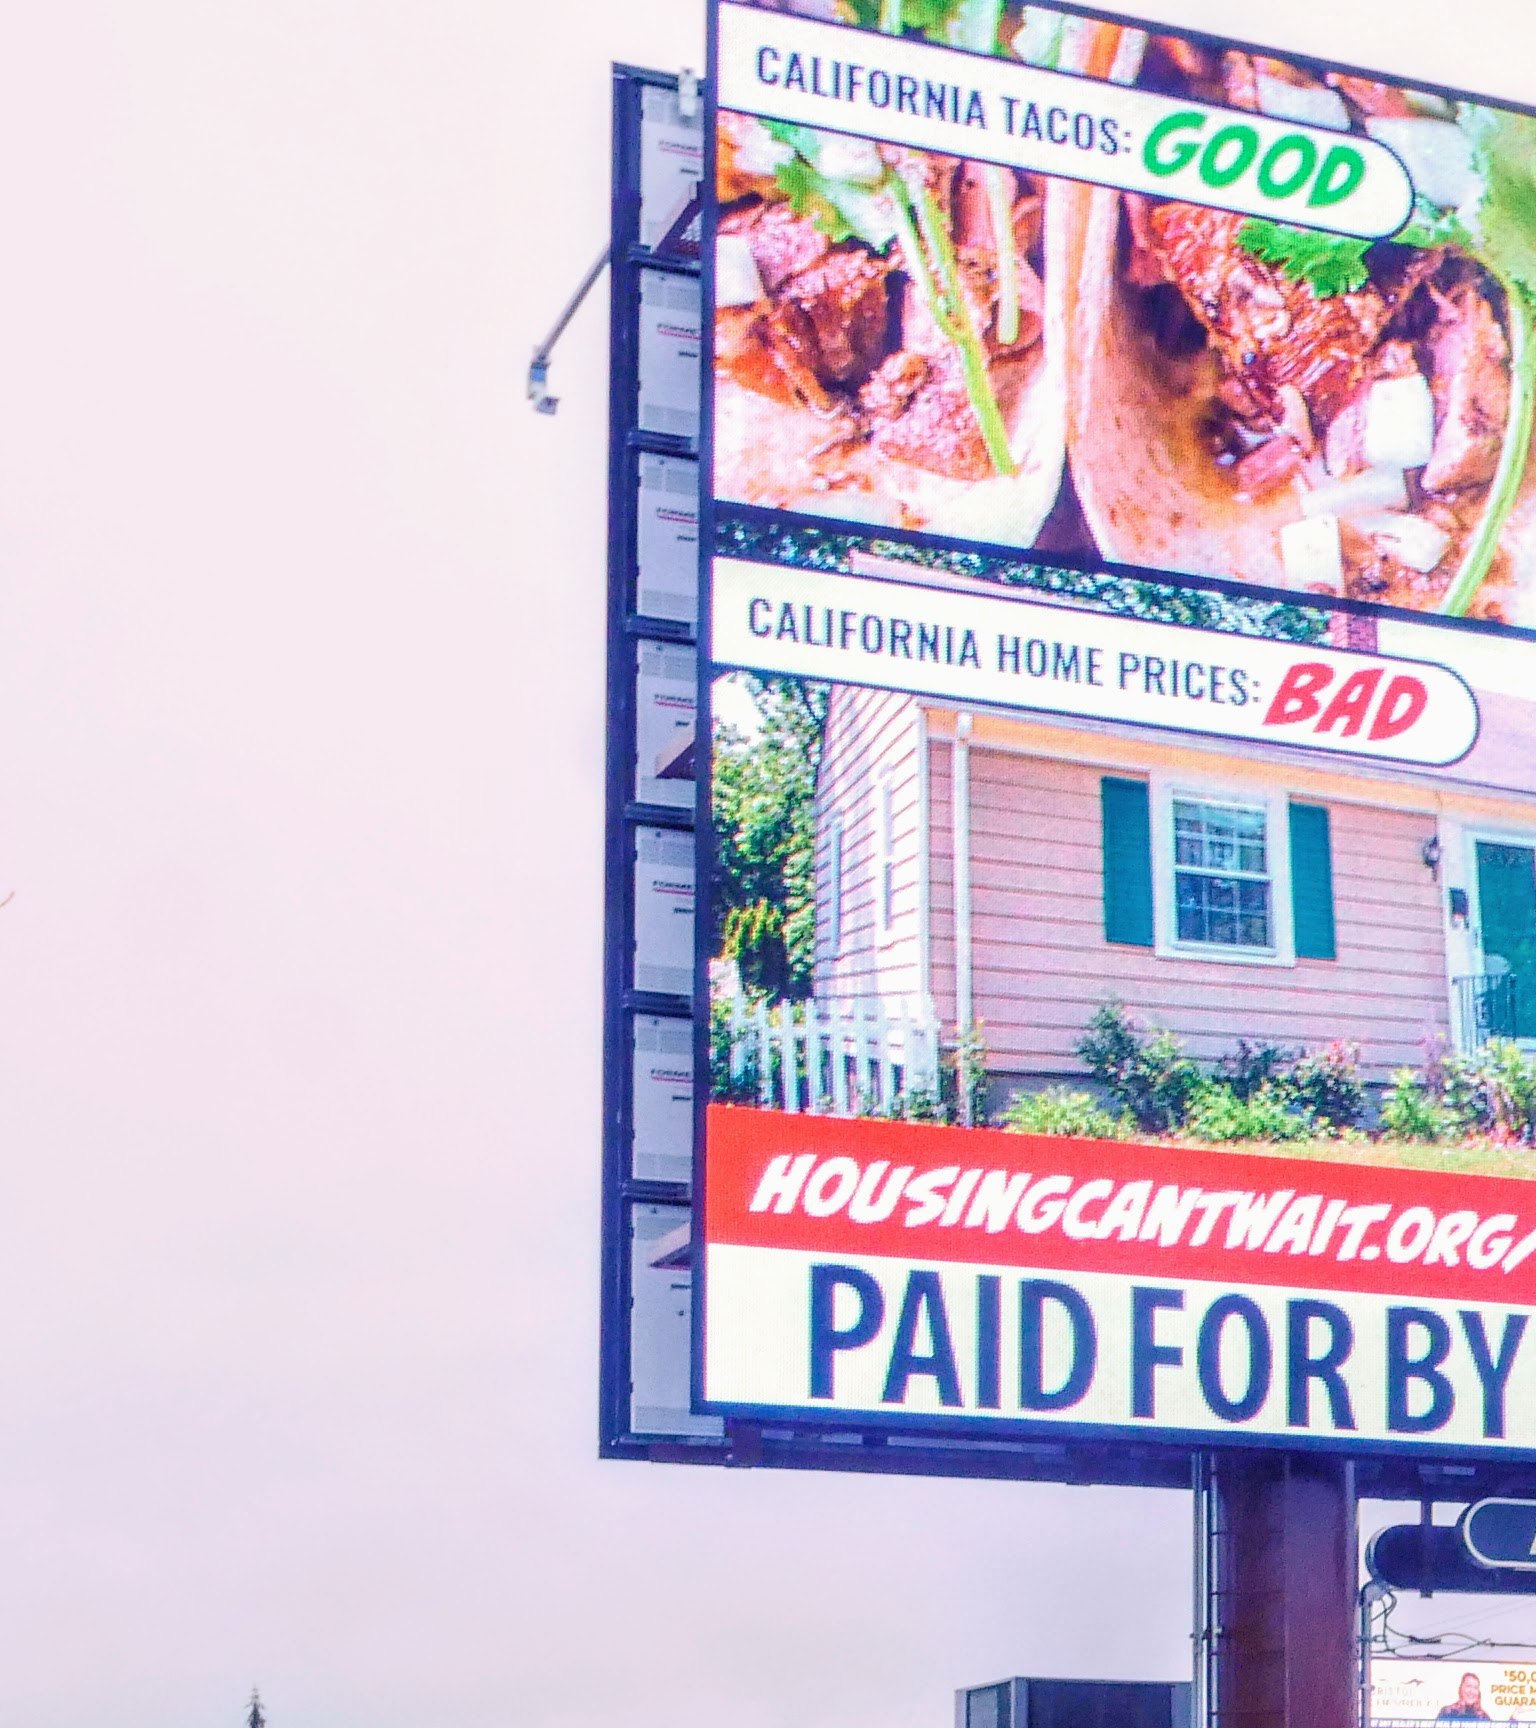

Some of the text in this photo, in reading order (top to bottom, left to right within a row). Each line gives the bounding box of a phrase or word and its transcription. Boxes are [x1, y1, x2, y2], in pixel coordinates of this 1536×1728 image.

[756, 45, 1366, 209] CALIFORNIA TACOS: GOOD
[748, 596, 1428, 742] CALIFORNIA HOME PRICES: BAD
[808, 1262, 1098, 1412] PAID
[1130, 1285, 1358, 1431] FOR
[1385, 1305, 1532, 1439] BY
[1491, 1684, 1528, 1695] PRICE
